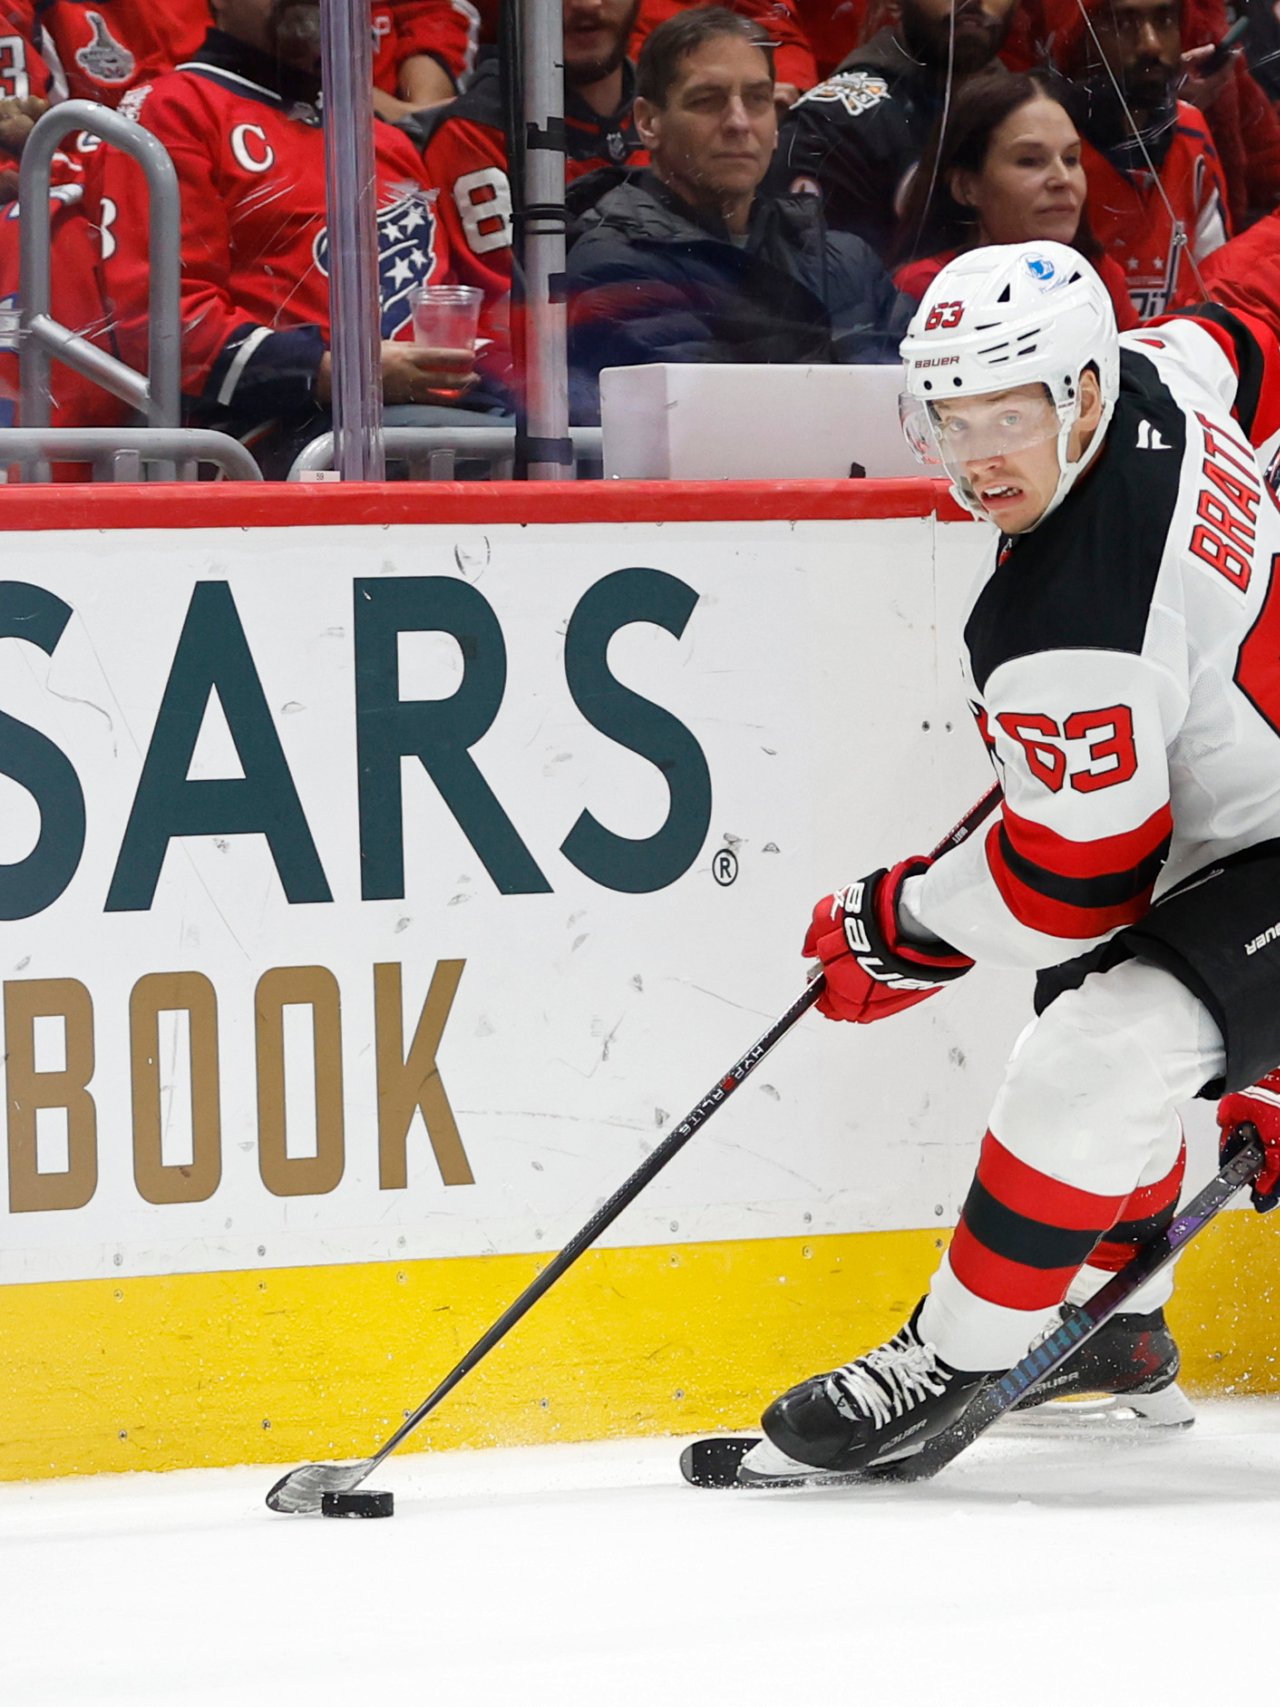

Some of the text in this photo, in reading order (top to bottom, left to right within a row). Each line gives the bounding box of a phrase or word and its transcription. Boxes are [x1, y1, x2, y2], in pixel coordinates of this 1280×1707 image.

[231, 123, 274, 172] C
[453, 166, 514, 254] 8
[924, 300, 966, 331] 63
[914, 355, 960, 368] BAUER
[1188, 409, 1262, 594] BRATT
[0, 566, 713, 922] SARS
[995, 703, 1139, 794] 63
[844, 882, 947, 991] BAUE
[2, 958, 477, 1214] BOOK
[1030, 1371, 1079, 1394] AUER
